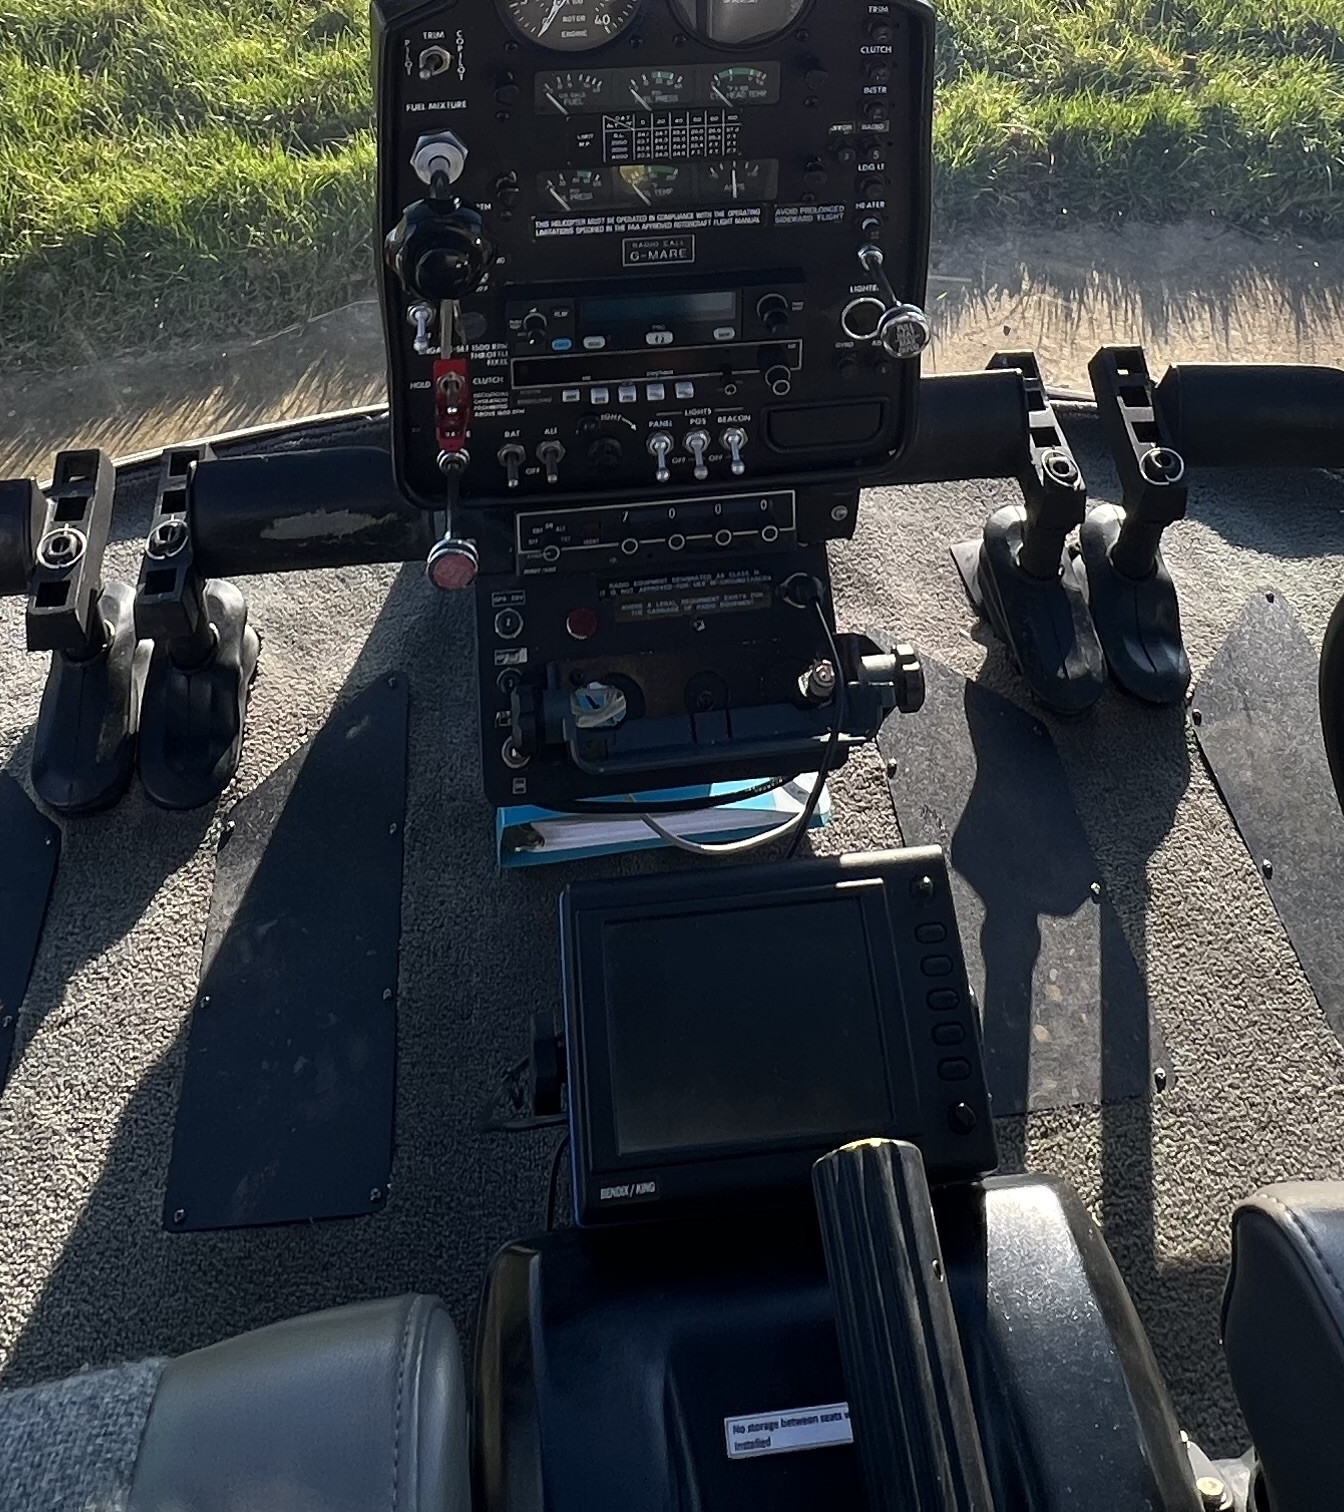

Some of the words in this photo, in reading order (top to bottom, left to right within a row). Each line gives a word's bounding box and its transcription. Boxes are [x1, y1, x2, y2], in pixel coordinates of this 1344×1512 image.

[868, 5, 889, 13] TRIM
[594, 14, 611, 25] 40
[423, 31, 445, 39] TRIM
[456, 29, 466, 81] COPILOT
[860, 45, 892, 54] CLUTCH
[404, 39, 413, 76] PILOT
[406, 104, 425, 112] FUEL
[428, 100, 467, 109] MIXTURE
[858, 163, 875, 171] LDG
[775, 207, 799, 216] AVOID
[800, 205, 845, 215] PROLONGED
[817, 213, 844, 221] FLIGHT
[410, 380, 431, 389] HOLD
[684, 407, 712, 416] LIGHTS
[690, 417, 707, 425] POS
[717, 414, 751, 424] BEACON
[668, 508, 676, 519] 0
[714, 503, 722, 515] 0
[760, 499, 768, 511] 0
[733, 1424, 746, 1434] No
[747, 1421, 779, 1433] storage
[780, 1416, 819, 1428] between
[820, 1412, 842, 1423] seats
